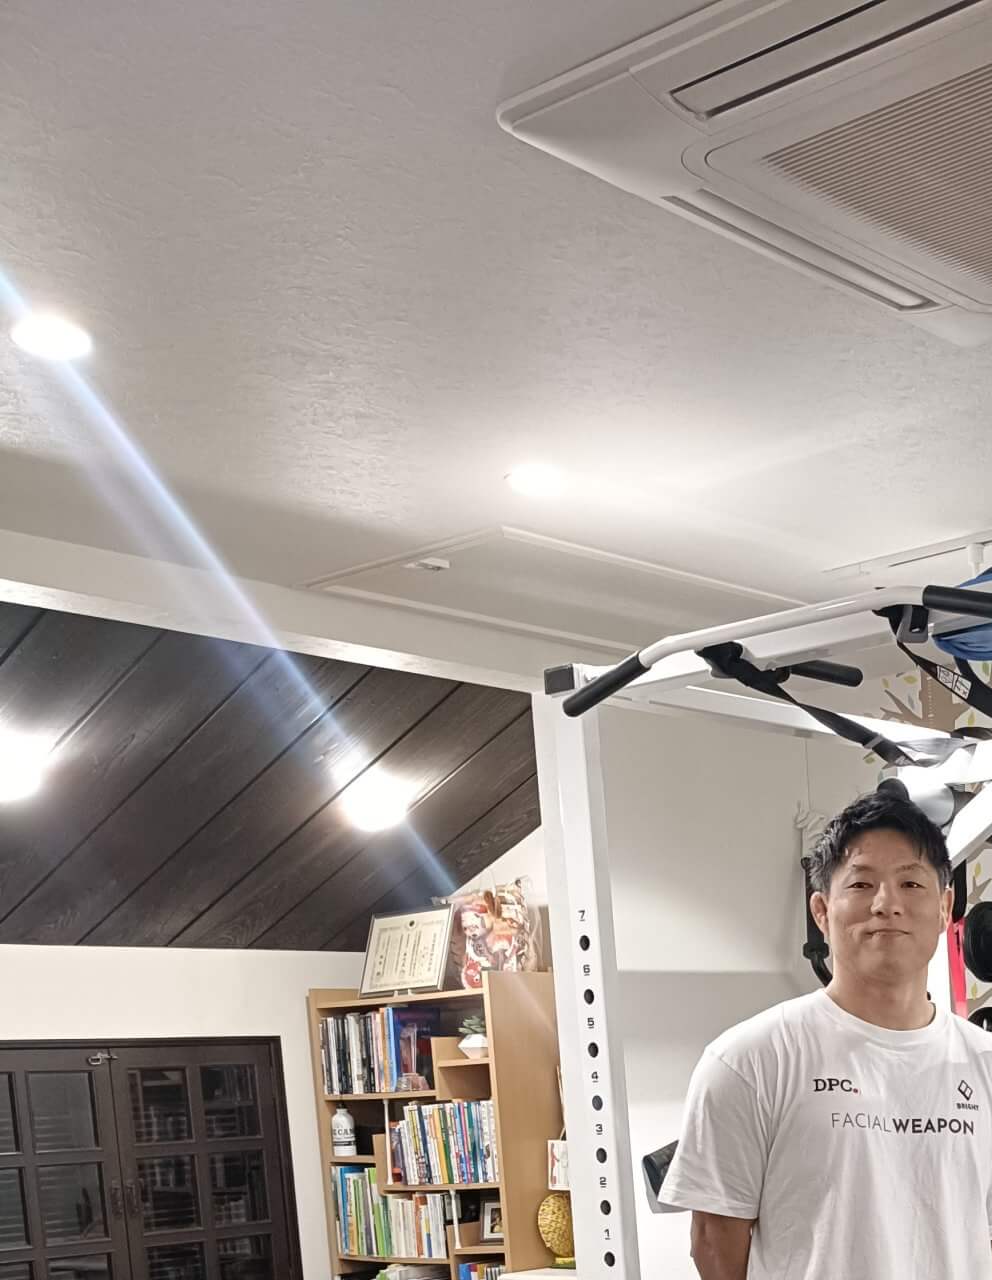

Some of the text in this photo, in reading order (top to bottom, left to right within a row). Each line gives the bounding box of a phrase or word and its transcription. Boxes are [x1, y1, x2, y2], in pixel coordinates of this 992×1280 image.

[579, 910, 585, 921] 7
[583, 965, 590, 976] 6
[588, 1018, 594, 1028] 5
[592, 1072, 598, 1082] 4
[596, 1124, 602, 1135] 3
[600, 1177, 606, 1188] 2
[605, 1229, 609, 1240] 1
